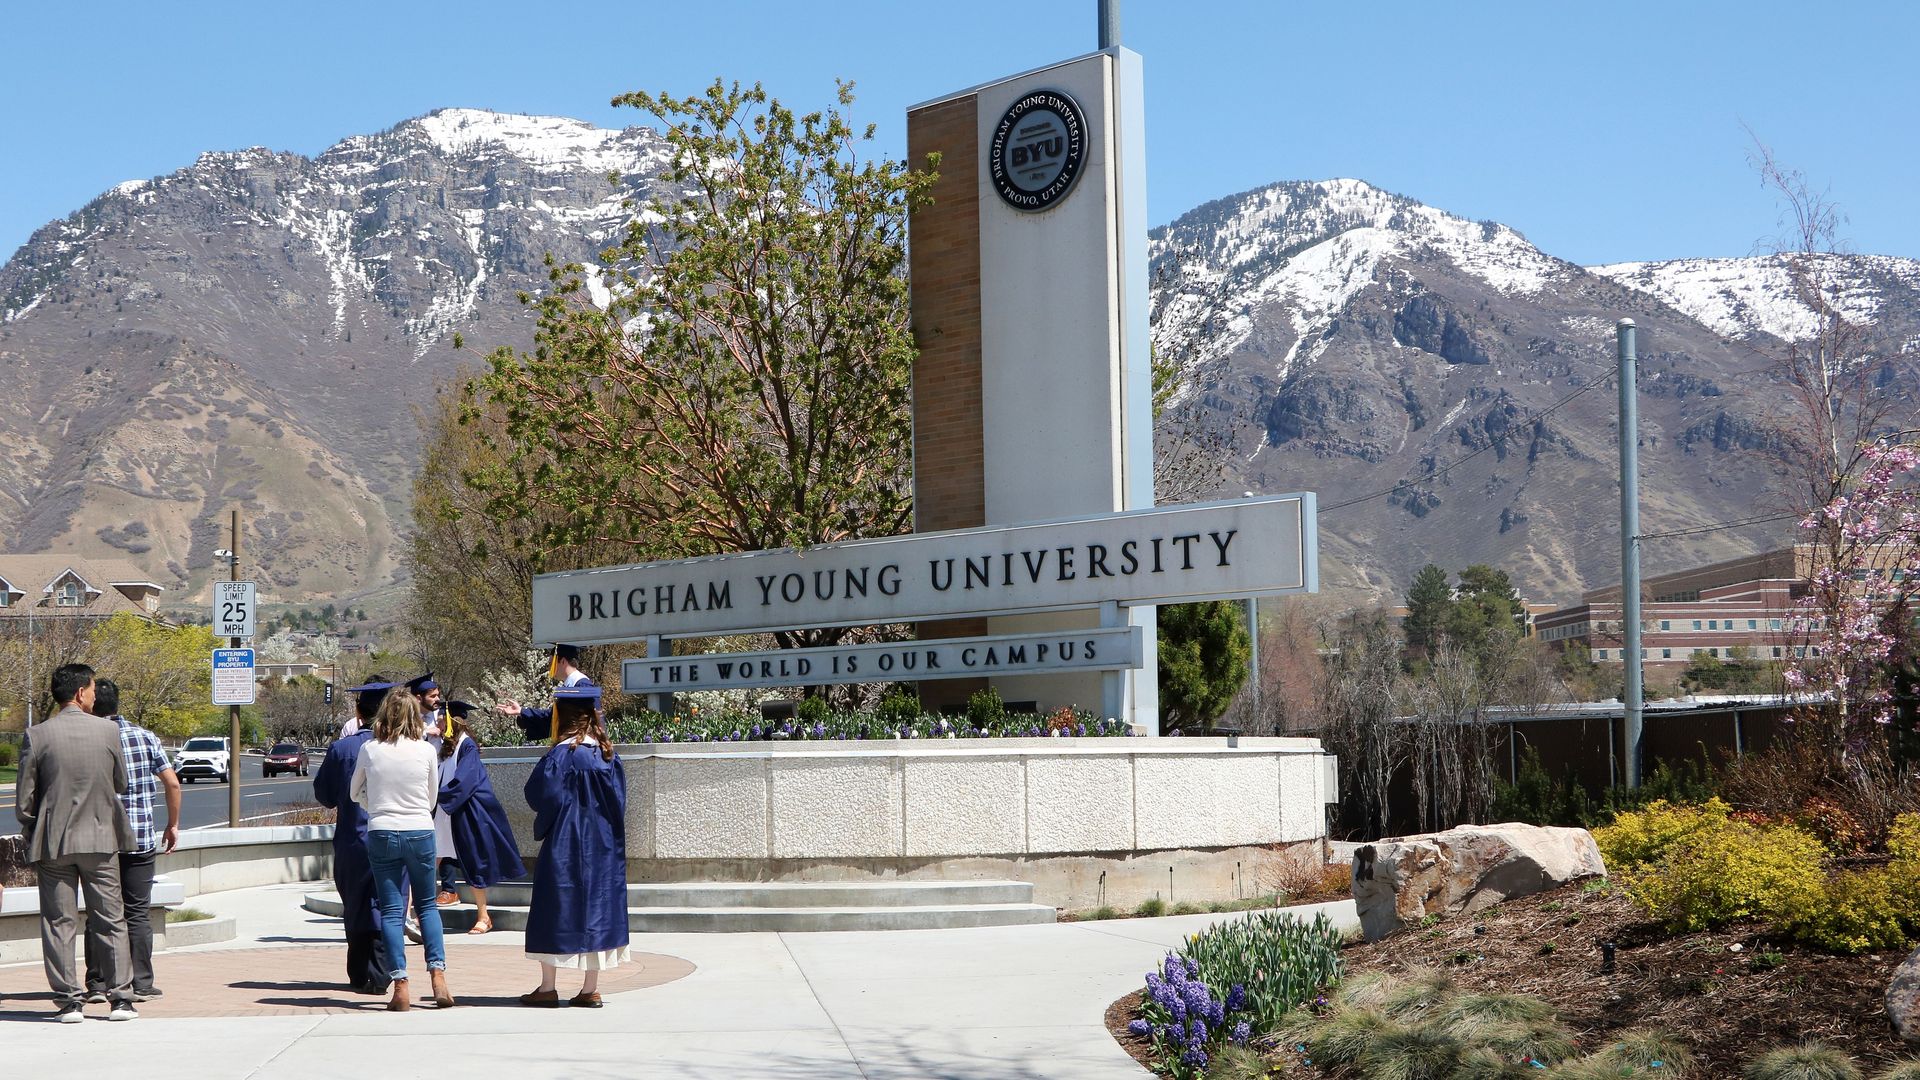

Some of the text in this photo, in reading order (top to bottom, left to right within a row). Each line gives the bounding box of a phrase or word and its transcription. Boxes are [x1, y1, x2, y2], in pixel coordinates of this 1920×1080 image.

[992, 95, 1080, 178] BRIGHAM YOUNG UNIVERSITY
[1011, 136, 1063, 167] BYU
[1003, 172, 1070, 205] PROVO, UTAH
[223, 583, 247, 592] SPEED
[567, 530, 1238, 622] BRIGHAM YOUNG UNIVERSITY
[222, 602, 247, 622] 25
[225, 592, 244, 601] LIMIT
[224, 624, 244, 634] MPH
[649, 640, 1098, 684] THE WORLD IS OUR CAMPUS
